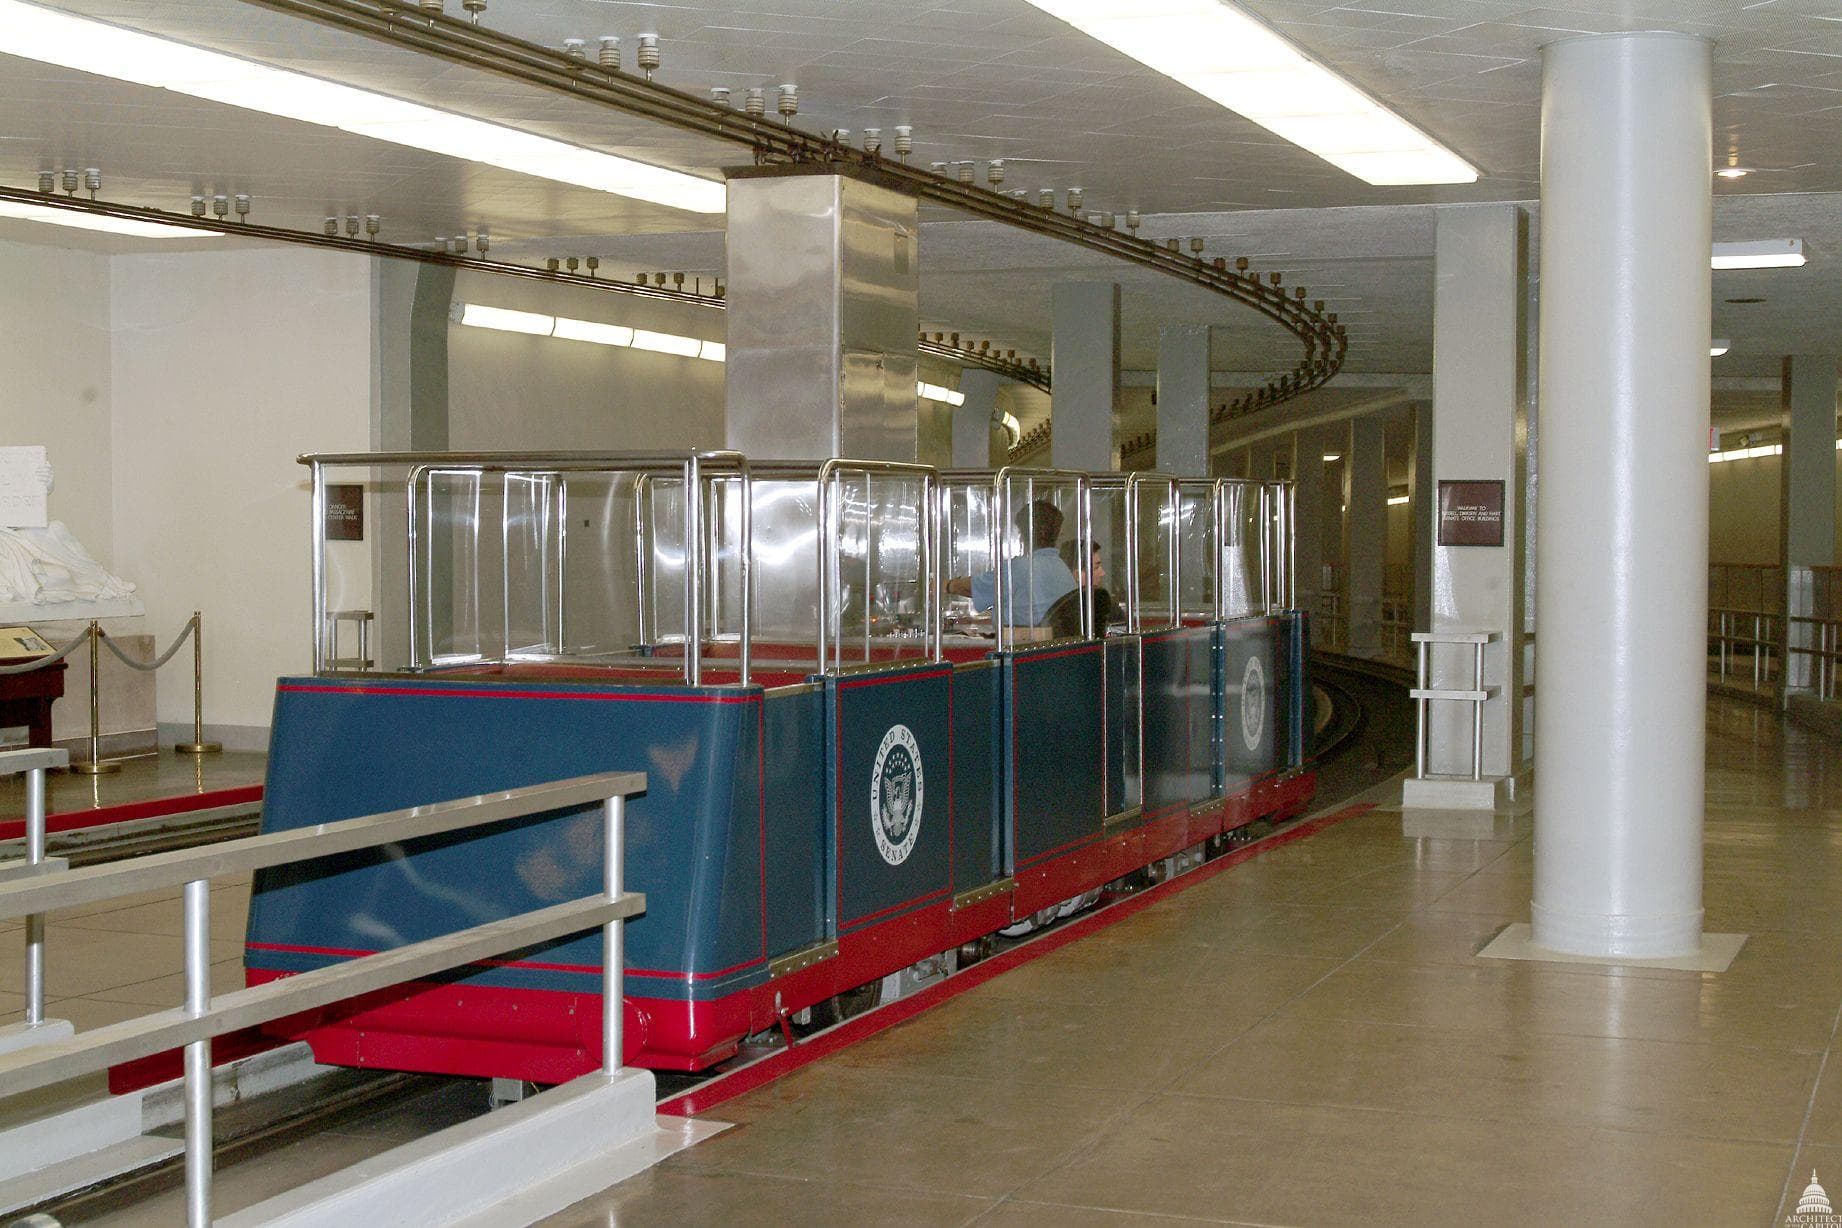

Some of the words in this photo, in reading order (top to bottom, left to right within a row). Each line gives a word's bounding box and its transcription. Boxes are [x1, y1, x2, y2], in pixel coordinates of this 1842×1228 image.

[873, 730, 895, 800] UNITED
[900, 728, 922, 792] STATES
[880, 833, 914, 861] SENATE
